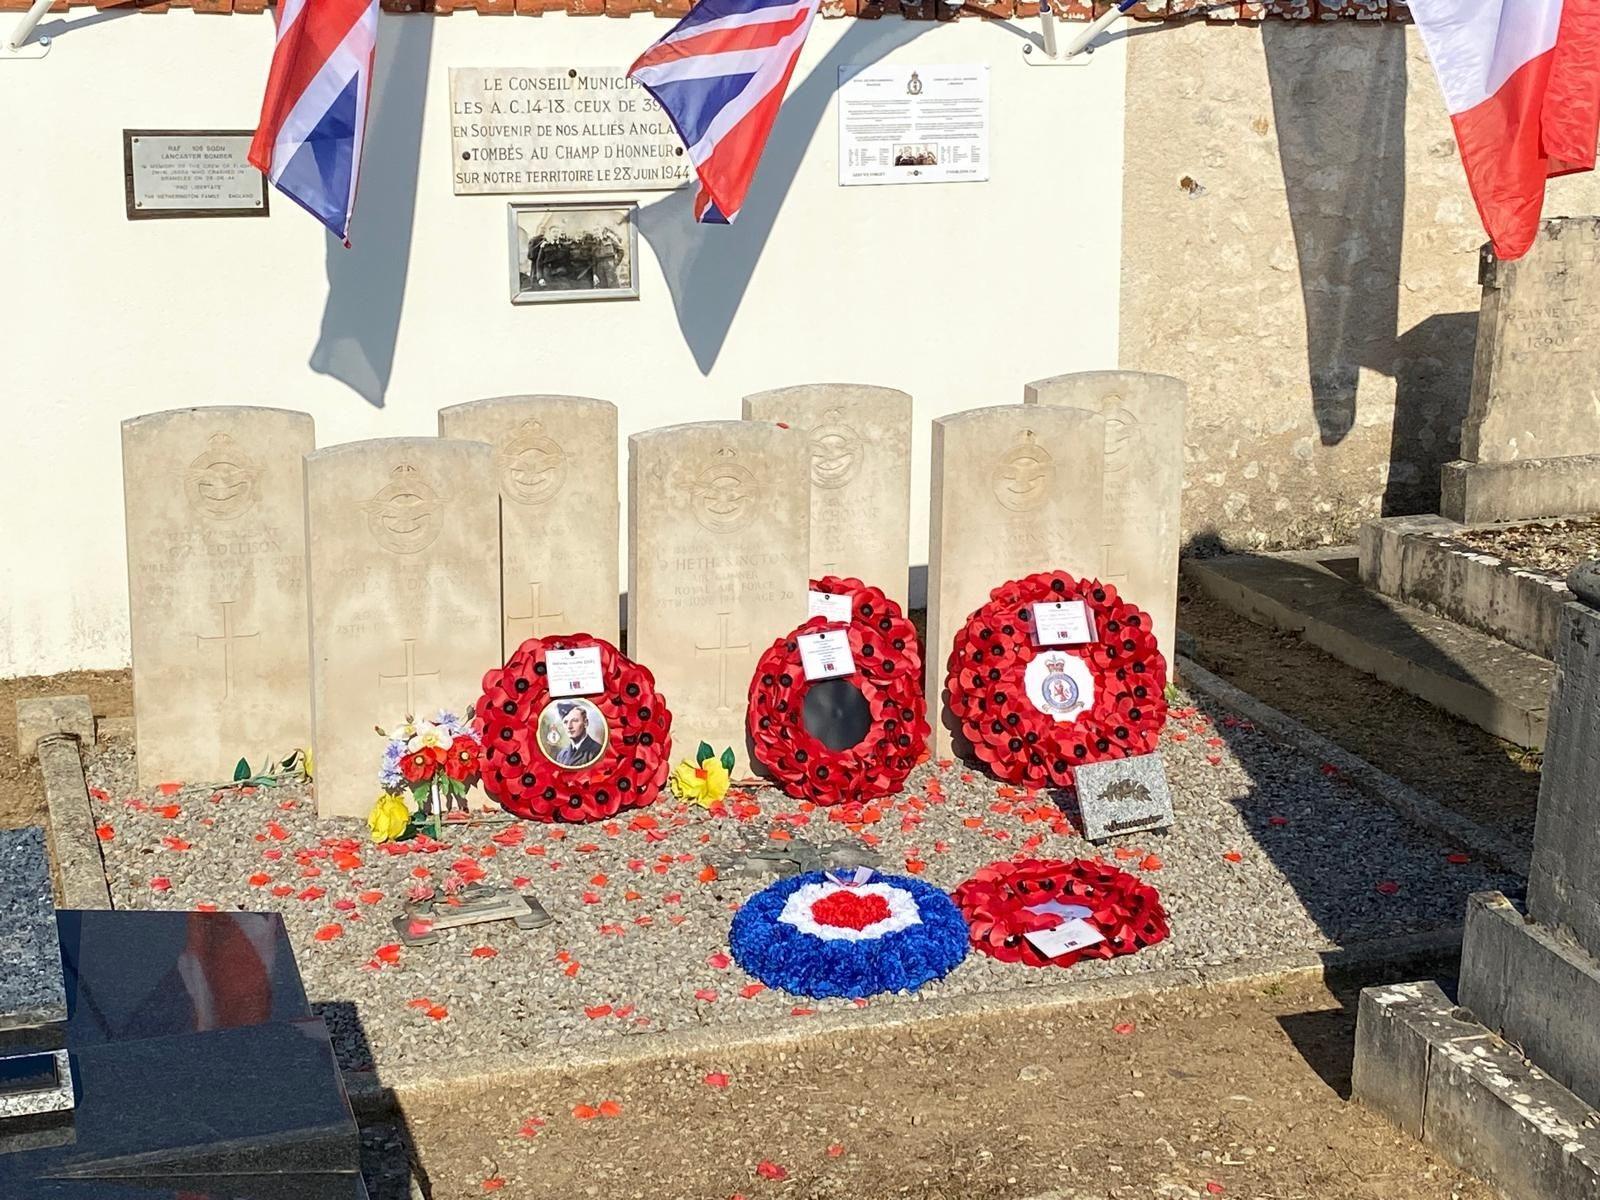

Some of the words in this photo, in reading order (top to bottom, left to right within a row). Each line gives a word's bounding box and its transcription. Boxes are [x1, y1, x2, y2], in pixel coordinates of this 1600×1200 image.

[483, 78, 503, 91] LE
[508, 77, 571, 91] CONSEIL
[578, 76, 642, 91] MUNICIP
[453, 101, 484, 114] LES
[574, 100, 612, 113] CEUX
[618, 100, 637, 113] DE
[453, 126, 468, 137] EN
[471, 123, 532, 137] SOUVENIR
[537, 125, 552, 137] DE
[556, 125, 579, 136] NOS
[629, 121, 679, 136] ANGLA
[531, 146, 549, 160] AU
[555, 145, 600, 159] CHAMP
[455, 172, 480, 184] SUR
[483, 171, 522, 184] NOTRE
[526, 169, 594, 183] TERRITOIRE
[597, 169, 611, 181] LE
[613, 166, 632, 181] 28
[633, 168, 659, 180] JUIN
[661, 165, 690, 179] 1944
